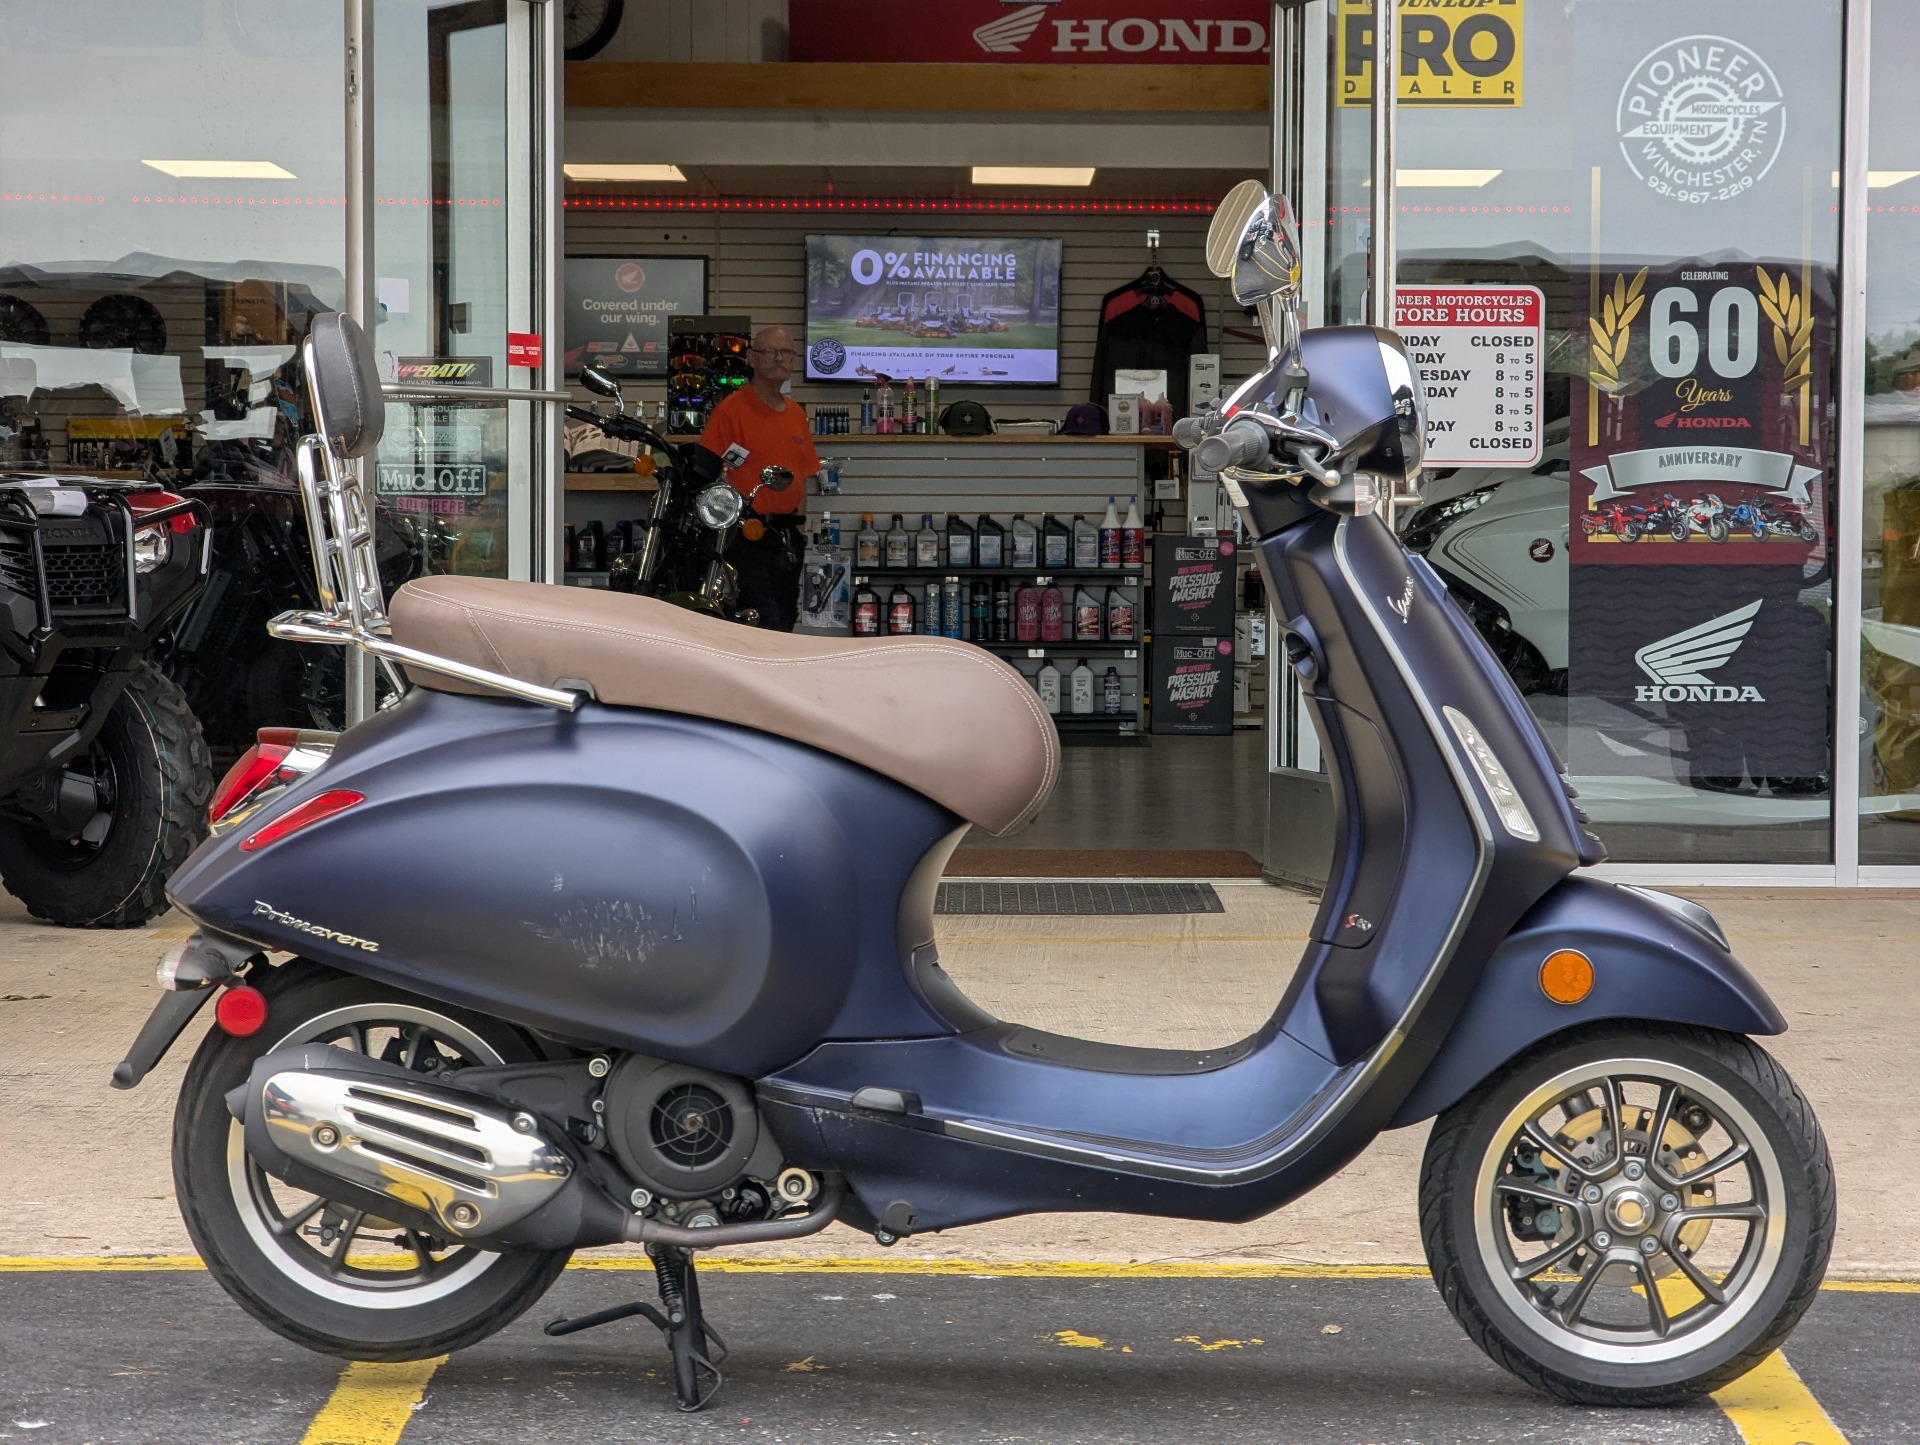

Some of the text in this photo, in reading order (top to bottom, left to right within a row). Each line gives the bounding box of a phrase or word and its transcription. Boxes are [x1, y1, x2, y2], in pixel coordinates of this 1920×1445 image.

[1398, 0, 1494, 8] UNLOP
[1051, 18, 1270, 52] HOND
[1344, 80, 1515, 94] DALER
[1628, 45, 1765, 116] PIONEER
[1691, 103, 1761, 116] MOTORCYCLES
[1642, 123, 1713, 136] EQUIPMENT
[1642, 120, 1769, 187] WINCHESTER, TN
[1647, 175, 1753, 204] 931-967-2219
[850, 249, 1017, 286] 0% FINANCING
[913, 266, 1016, 280] AVAILABLE
[1680, 271, 1729, 281] CELEBRATING
[582, 299, 680, 310] Covered under
[1396, 295, 1533, 306] NEER MOTORCYCLES
[601, 312, 660, 326] our wing.
[1396, 307, 1525, 323] TORE HOURS
[1650, 286, 1759, 378] 60
[1399, 335, 1534, 348] NDAY CLOSED
[1495, 353, 1505, 364] 8
[1524, 353, 1534, 364] 5
[398, 363, 475, 378] UPERATV
[1195, 363, 1215, 371] SP
[1420, 370, 1471, 381] ESDAY
[1495, 370, 1504, 381] 8
[1524, 370, 1534, 381] 5
[1495, 387, 1504, 398] 8
[1524, 387, 1534, 398] 5
[1675, 378, 1733, 412] Years
[1495, 404, 1504, 415] 8
[1524, 404, 1533, 415] 5
[1494, 421, 1504, 432] 8
[1523, 421, 1533, 432] 3
[1676, 417, 1751, 428] HONDA
[1469, 438, 1533, 449] CLOSED
[1658, 451, 1743, 469] ANNIVERSARY
[431, 500, 465, 513] HERE
[1178, 549, 1214, 559] Muc-Off
[1169, 570, 1223, 590] PRESSURE
[1171, 585, 1216, 603] WASHER
[1176, 649, 1213, 658] Muc-Off
[1167, 669, 1221, 690] PRESSURE
[1169, 684, 1214, 702] WASHER
[1634, 685, 1766, 702] HONDA
[252, 899, 380, 953] Primavera
